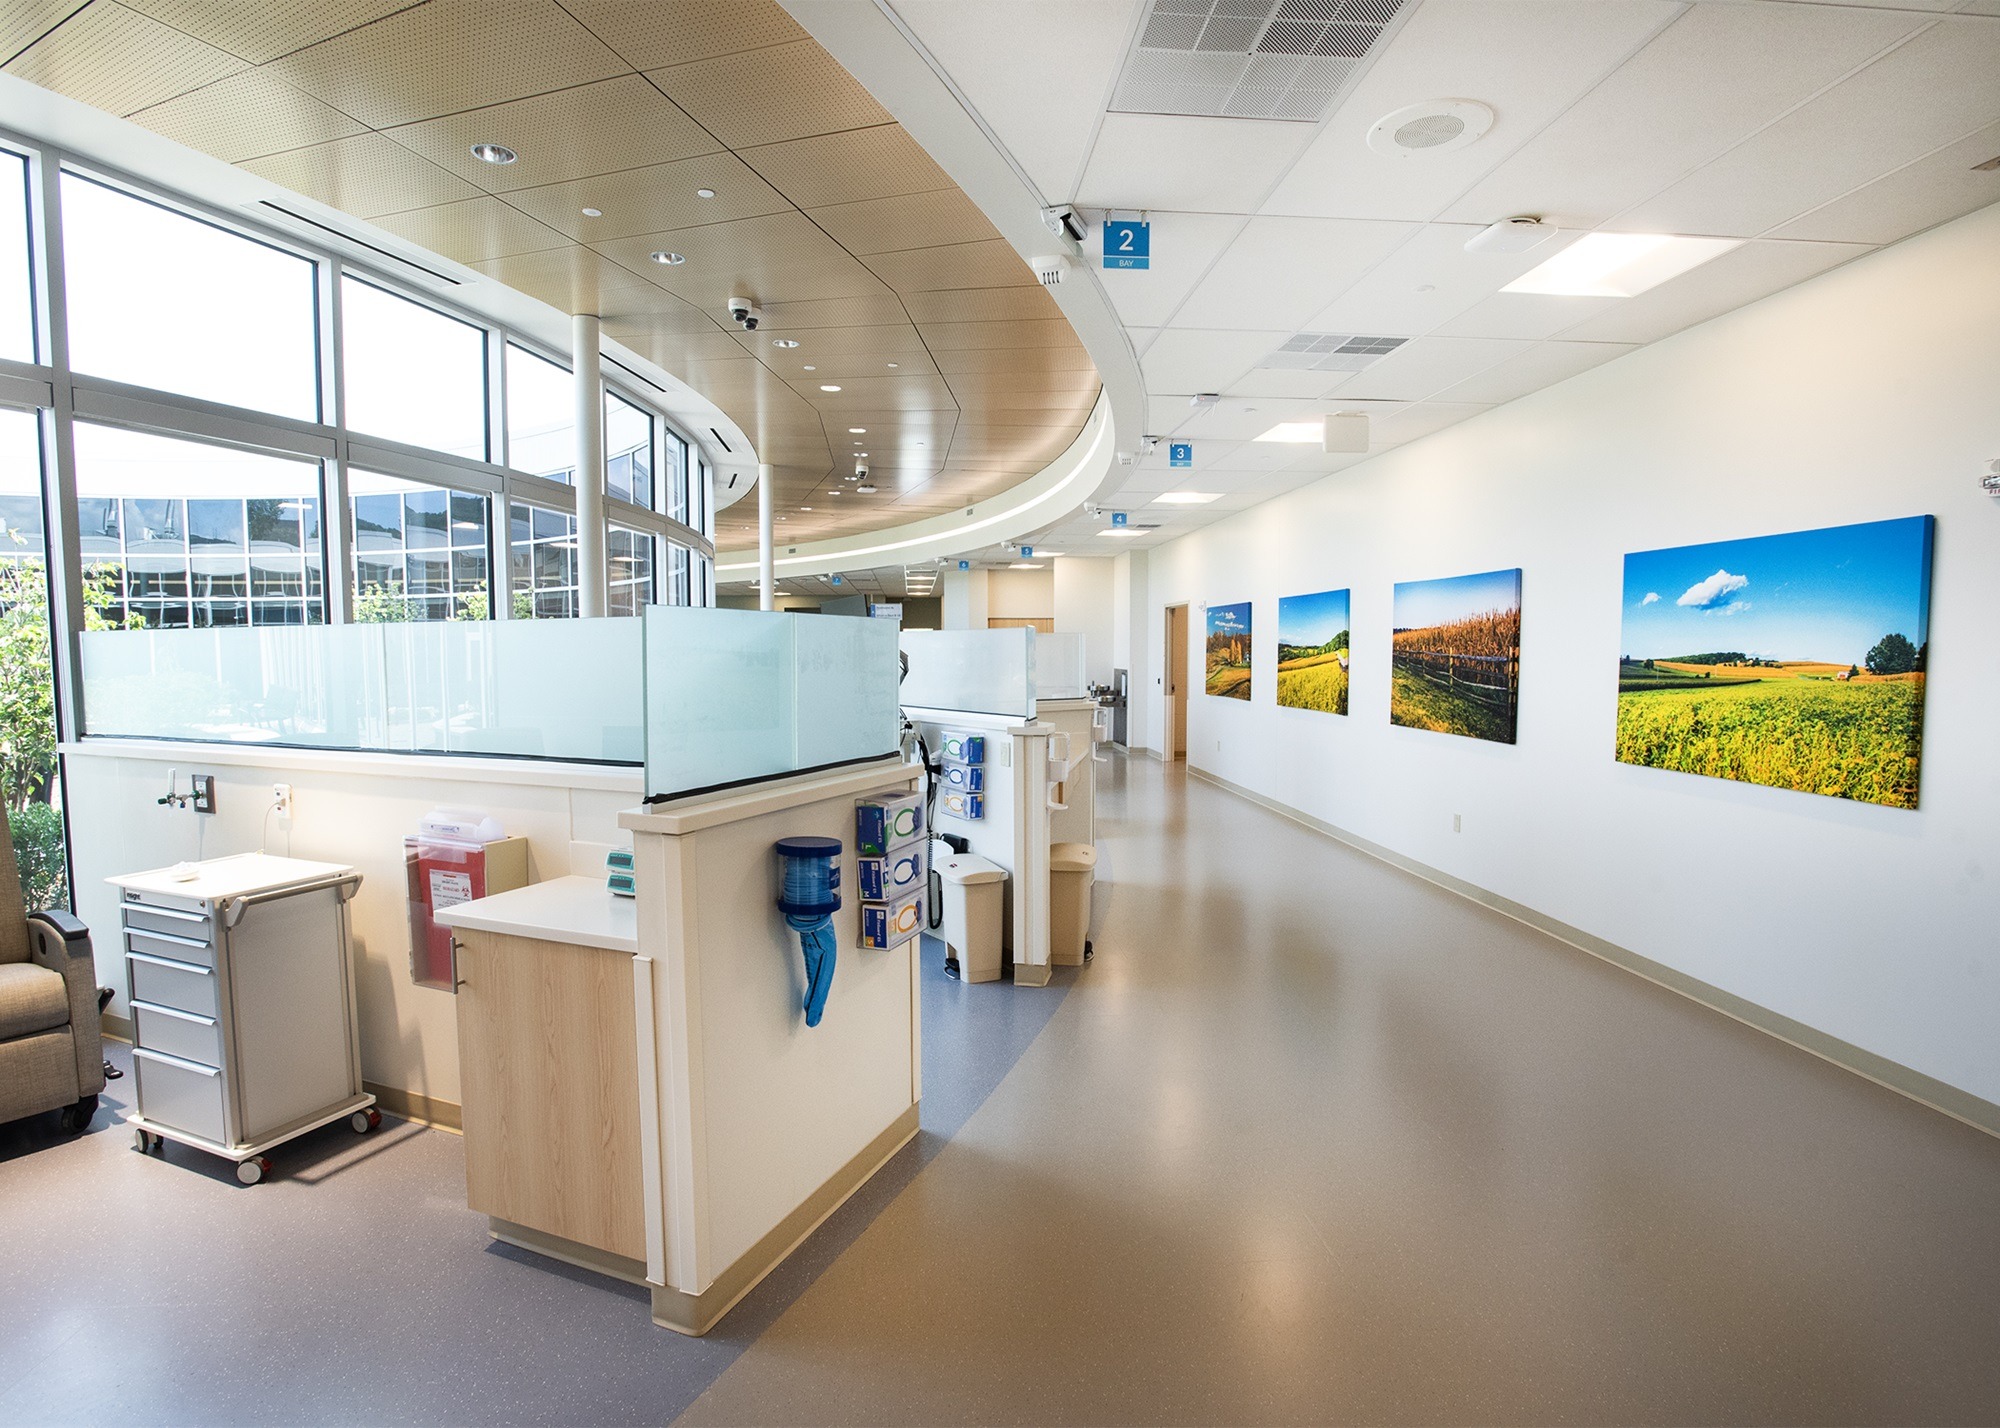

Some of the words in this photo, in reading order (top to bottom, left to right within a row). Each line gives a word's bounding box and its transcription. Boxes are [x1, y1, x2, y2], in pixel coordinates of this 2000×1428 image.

[1119, 229, 1134, 251] 2
[1176, 447, 1185, 459] 3
[1116, 515, 1123, 523] 4
